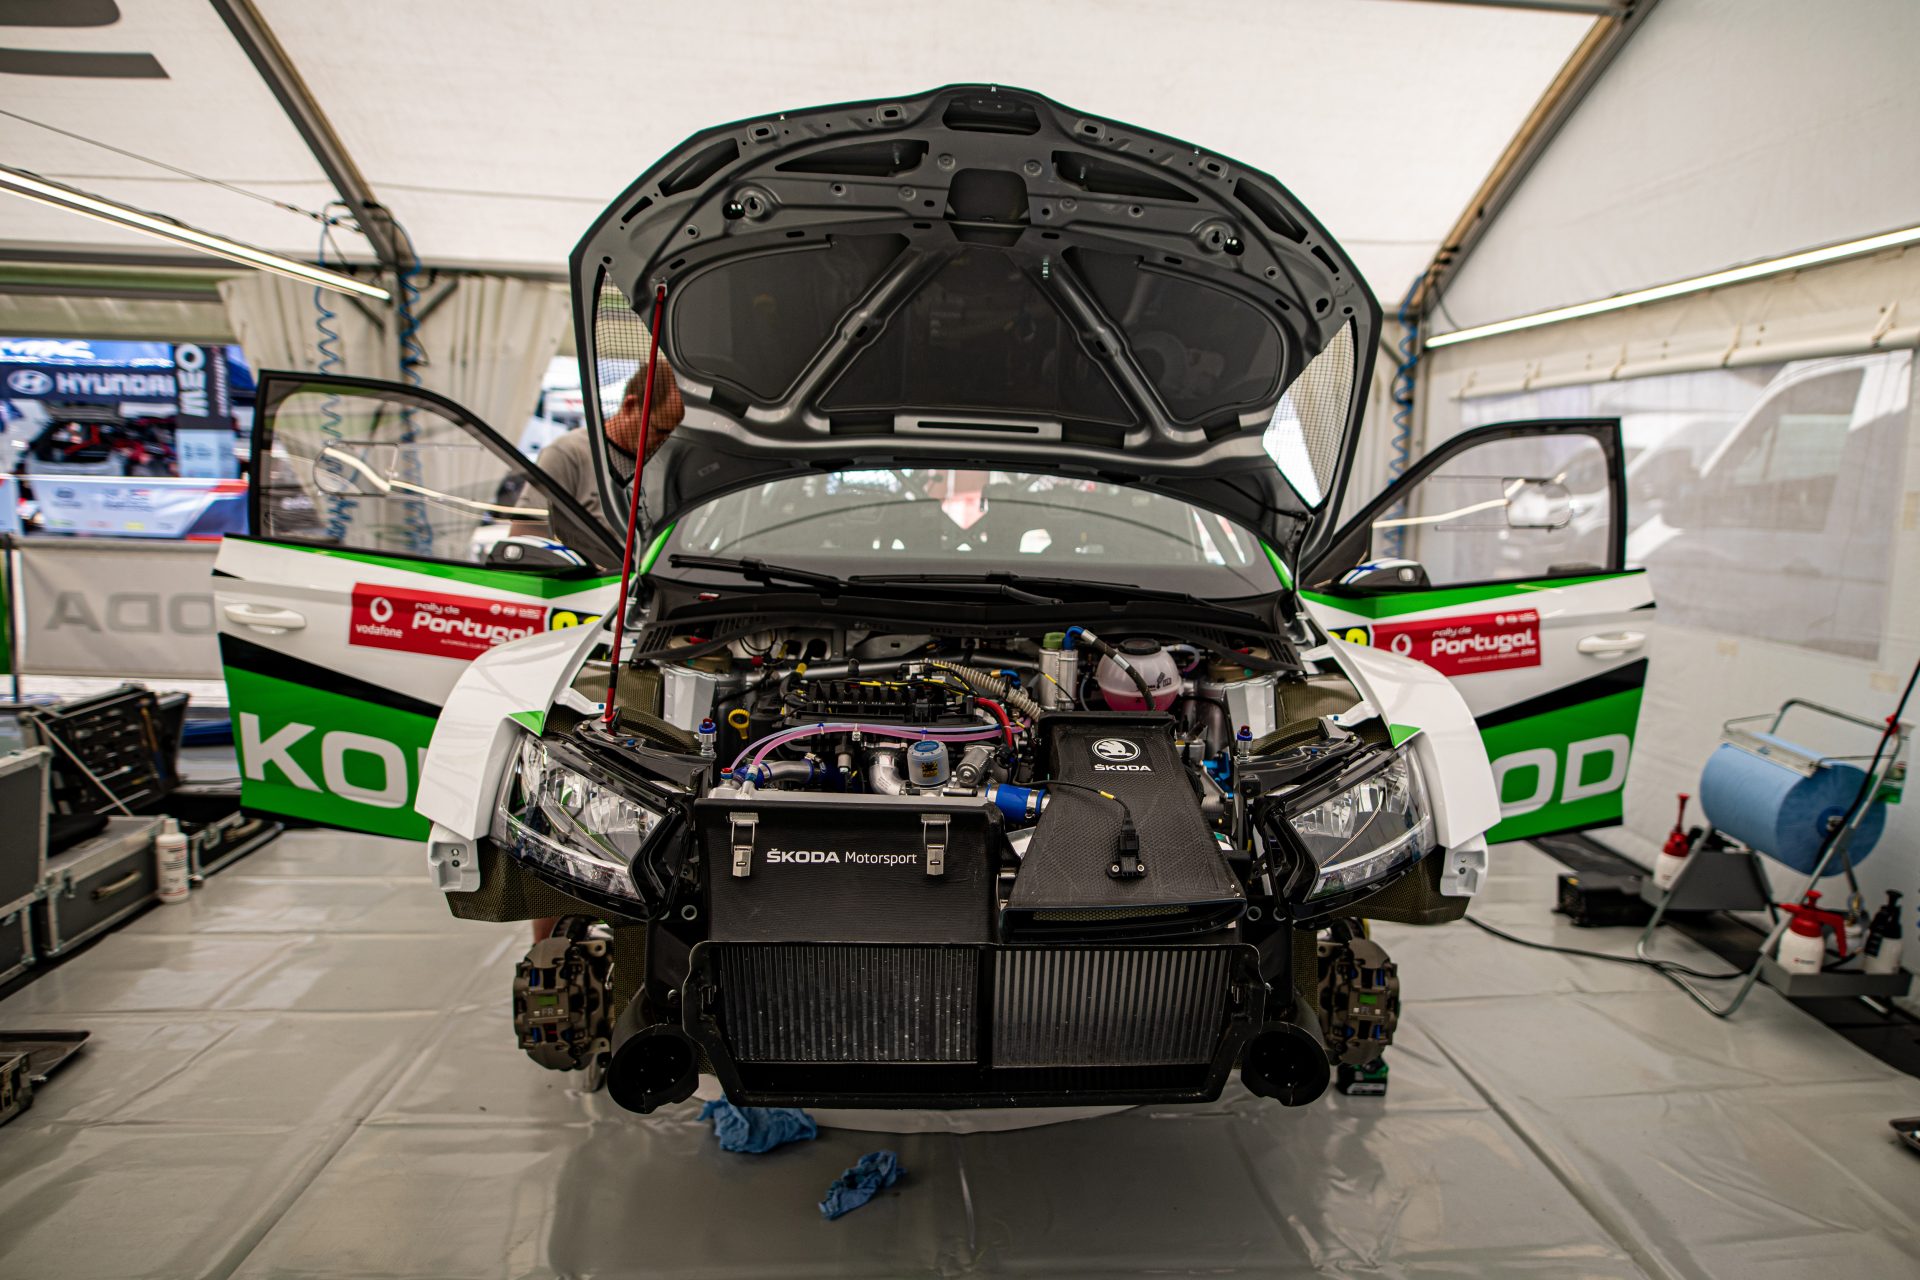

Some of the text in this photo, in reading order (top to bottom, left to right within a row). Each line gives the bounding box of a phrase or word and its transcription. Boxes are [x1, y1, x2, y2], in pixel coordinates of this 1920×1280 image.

[56, 372, 176, 396] HYUNDAI
[415, 603, 460, 615] rally de
[356, 624, 403, 638] vodafone
[1432, 625, 1472, 638] rally de
[1431, 628, 1536, 657] Portugal
[239, 712, 428, 808] KO
[766, 848, 917, 866] ŠKODA Motorsport
